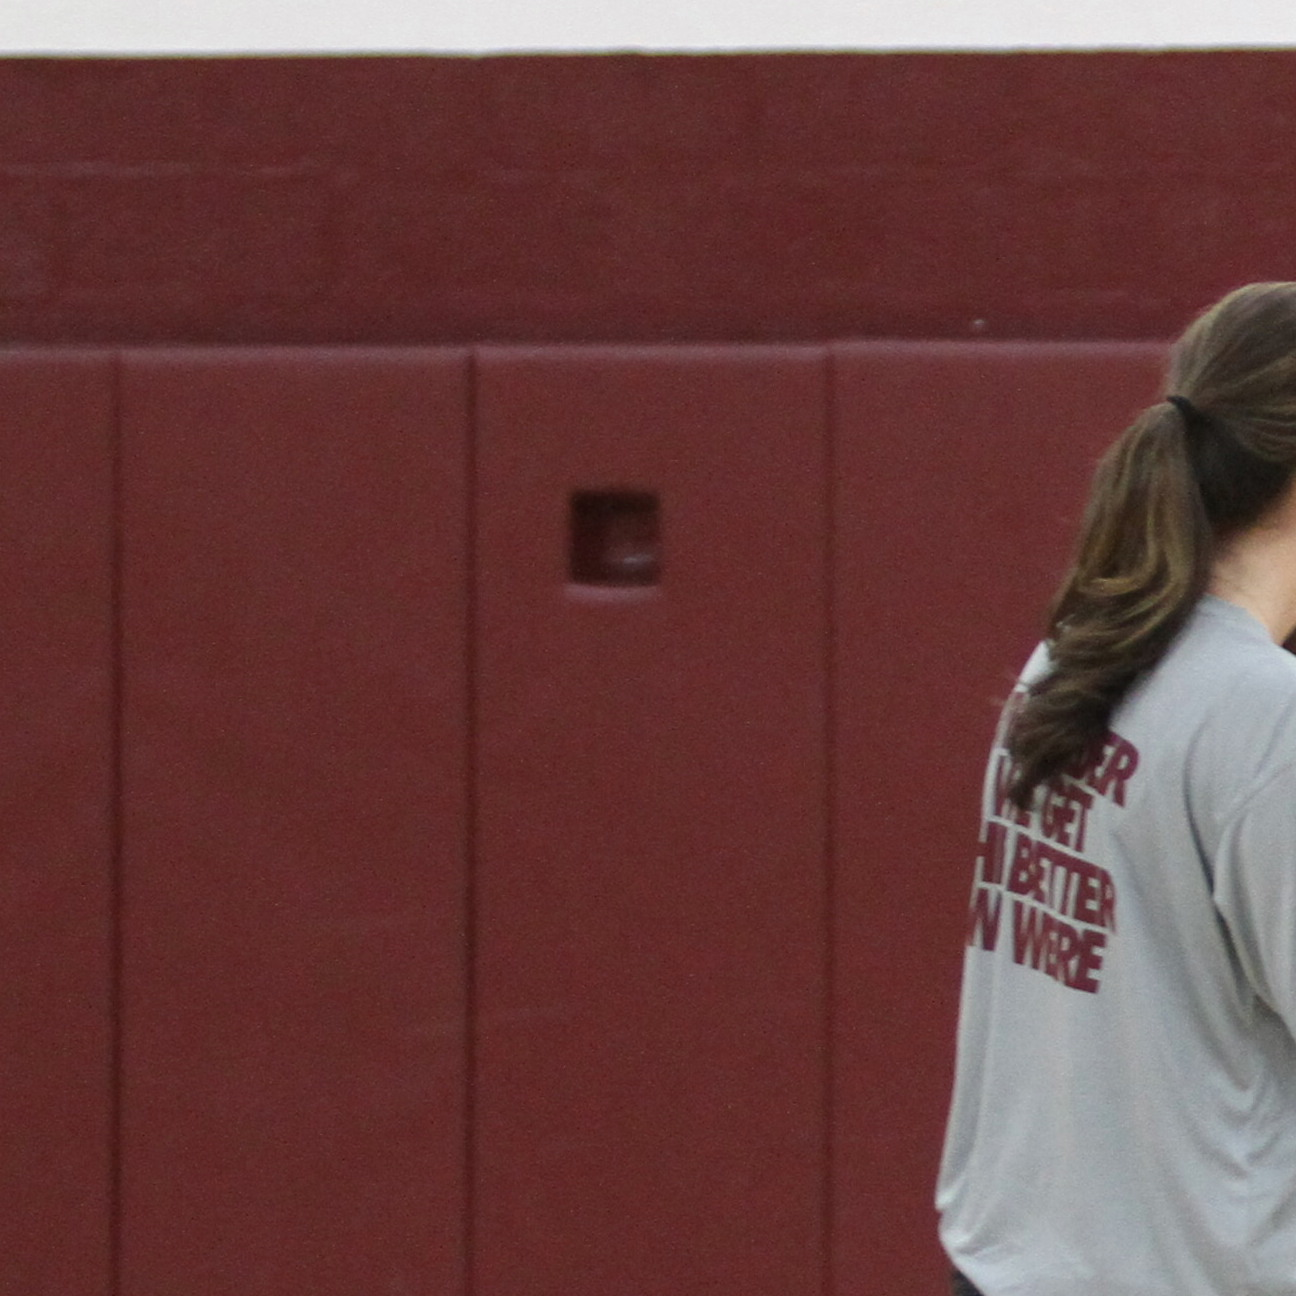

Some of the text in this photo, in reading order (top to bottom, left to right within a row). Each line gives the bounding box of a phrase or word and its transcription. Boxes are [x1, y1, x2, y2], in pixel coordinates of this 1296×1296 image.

[1040, 777, 1094, 853] GET
[1007, 831, 1117, 934] BETTER
[1012, 898, 1107, 994] WERE
